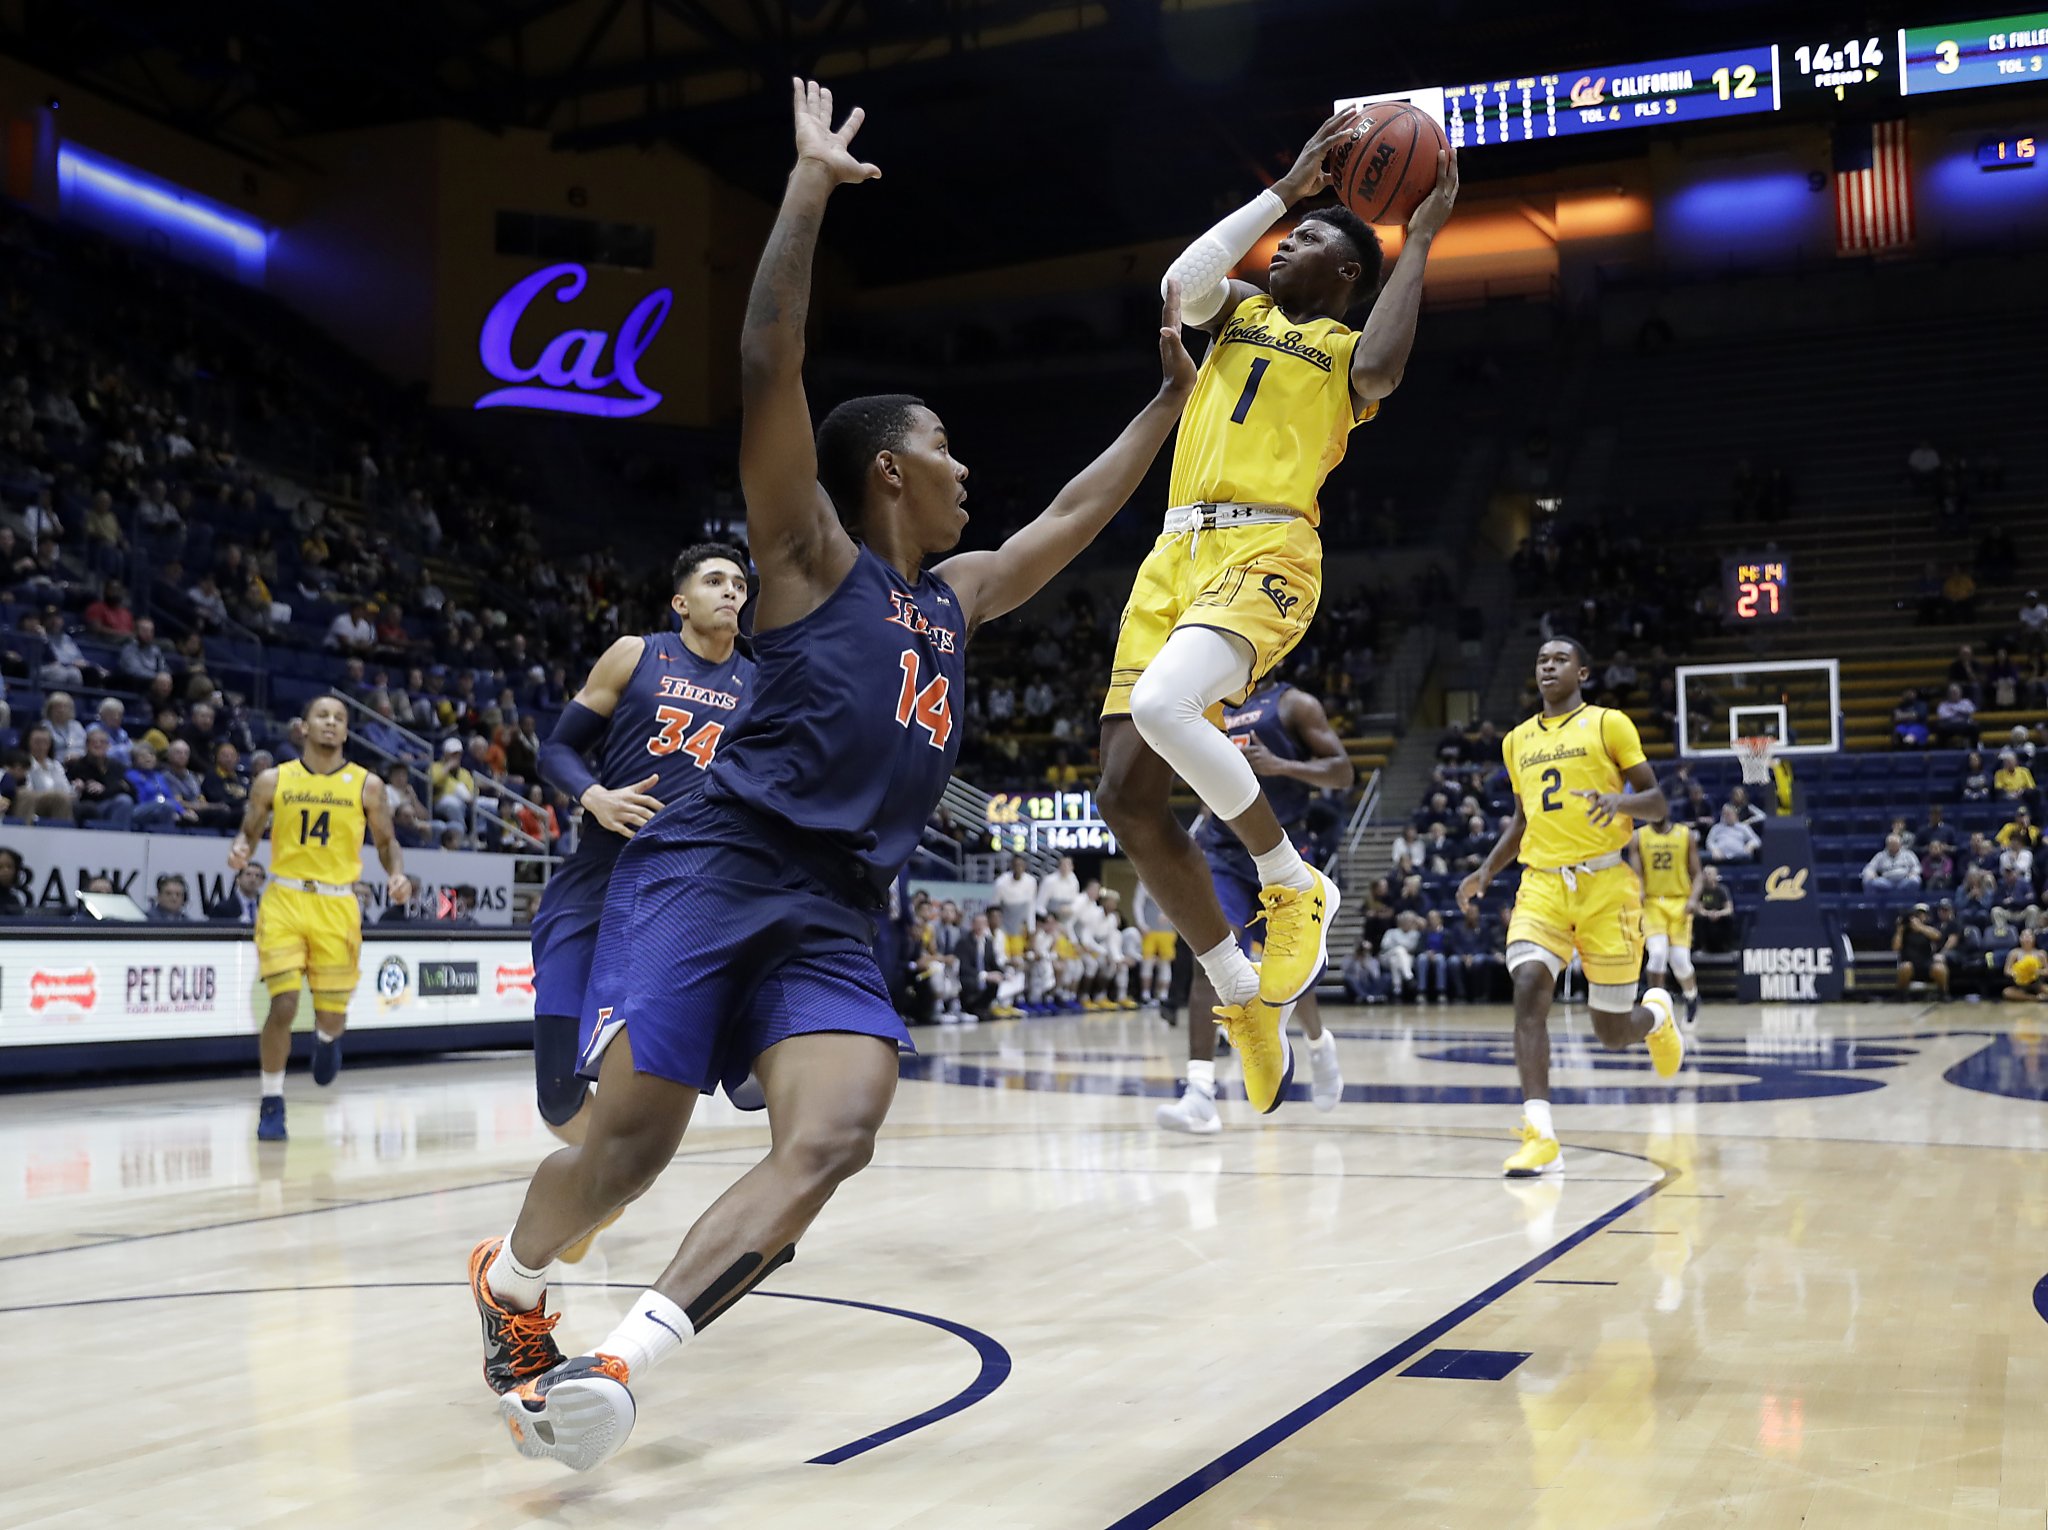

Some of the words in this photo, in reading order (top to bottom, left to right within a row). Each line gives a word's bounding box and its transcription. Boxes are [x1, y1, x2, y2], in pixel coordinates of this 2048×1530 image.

[1795, 38, 1883, 74] 14:14
[1935, 40, 1960, 74] 3
[1989, 34, 2005, 51] CS
[2009, 28, 2048, 48] FULLE
[1815, 70, 1863, 87] PERIOD
[1997, 58, 2026, 74] TOL
[2031, 55, 2042, 72] 3
[1611, 70, 1694, 98] CALIFORNIA
[1712, 65, 1757, 101] 12
[1834, 86, 1844, 101] 1
[1579, 109, 1606, 123] TOL
[1608, 105, 1621, 121] 4
[1635, 101, 1661, 117] FLS
[1665, 99, 1677, 114] 3
[1357, 142, 1396, 203] NCAA
[473, 262, 674, 418] Cal
[1220, 317, 1276, 346] Golden
[1275, 330, 1332, 369] Bears
[1231, 357, 1271, 425] 1
[1738, 563, 1782, 583] 14:14
[1257, 573, 1299, 619] Cal
[1737, 582, 1779, 618] 27
[884, 589, 956, 655] TINS
[656, 675, 739, 710] TITANS
[895, 648, 953, 752] 14
[646, 704, 725, 771] 34
[1541, 768, 1563, 812] 2
[300, 809, 330, 846] 14
[1652, 852, 1672, 870] 22
[1764, 865, 1809, 902] Cal
[1742, 947, 1833, 975] MUSCLE
[127, 966, 161, 1002] PET
[170, 966, 215, 1001] CLUB
[1760, 973, 1818, 1000] MILK
